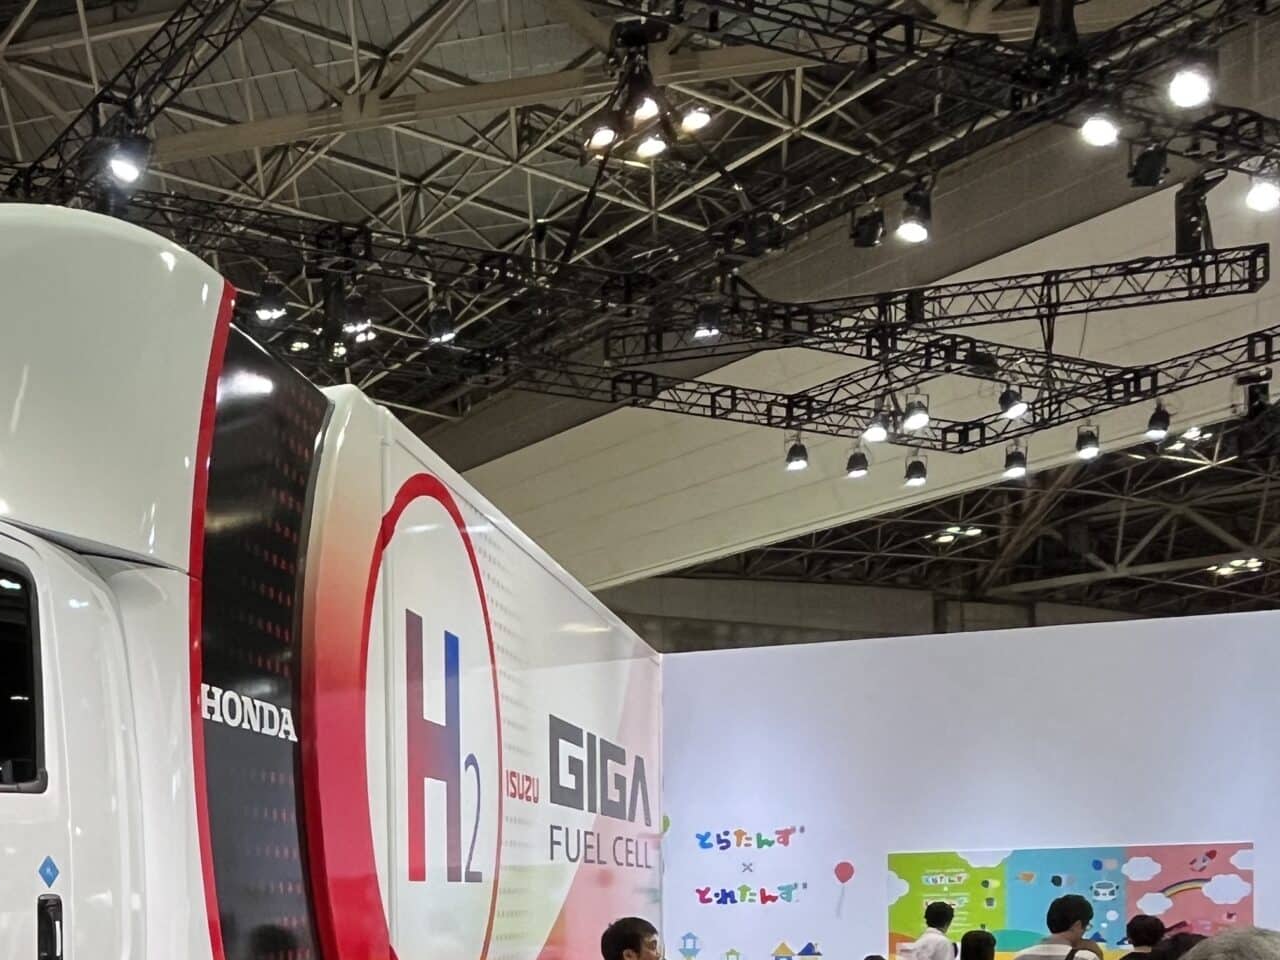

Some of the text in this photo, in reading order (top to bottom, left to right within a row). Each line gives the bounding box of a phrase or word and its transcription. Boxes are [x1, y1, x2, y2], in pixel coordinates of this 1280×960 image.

[201, 683, 298, 743] HONDA
[506, 769, 539, 804] ISUZU
[549, 714, 651, 827] GIGA
[550, 824, 652, 869] FUEL CELL
